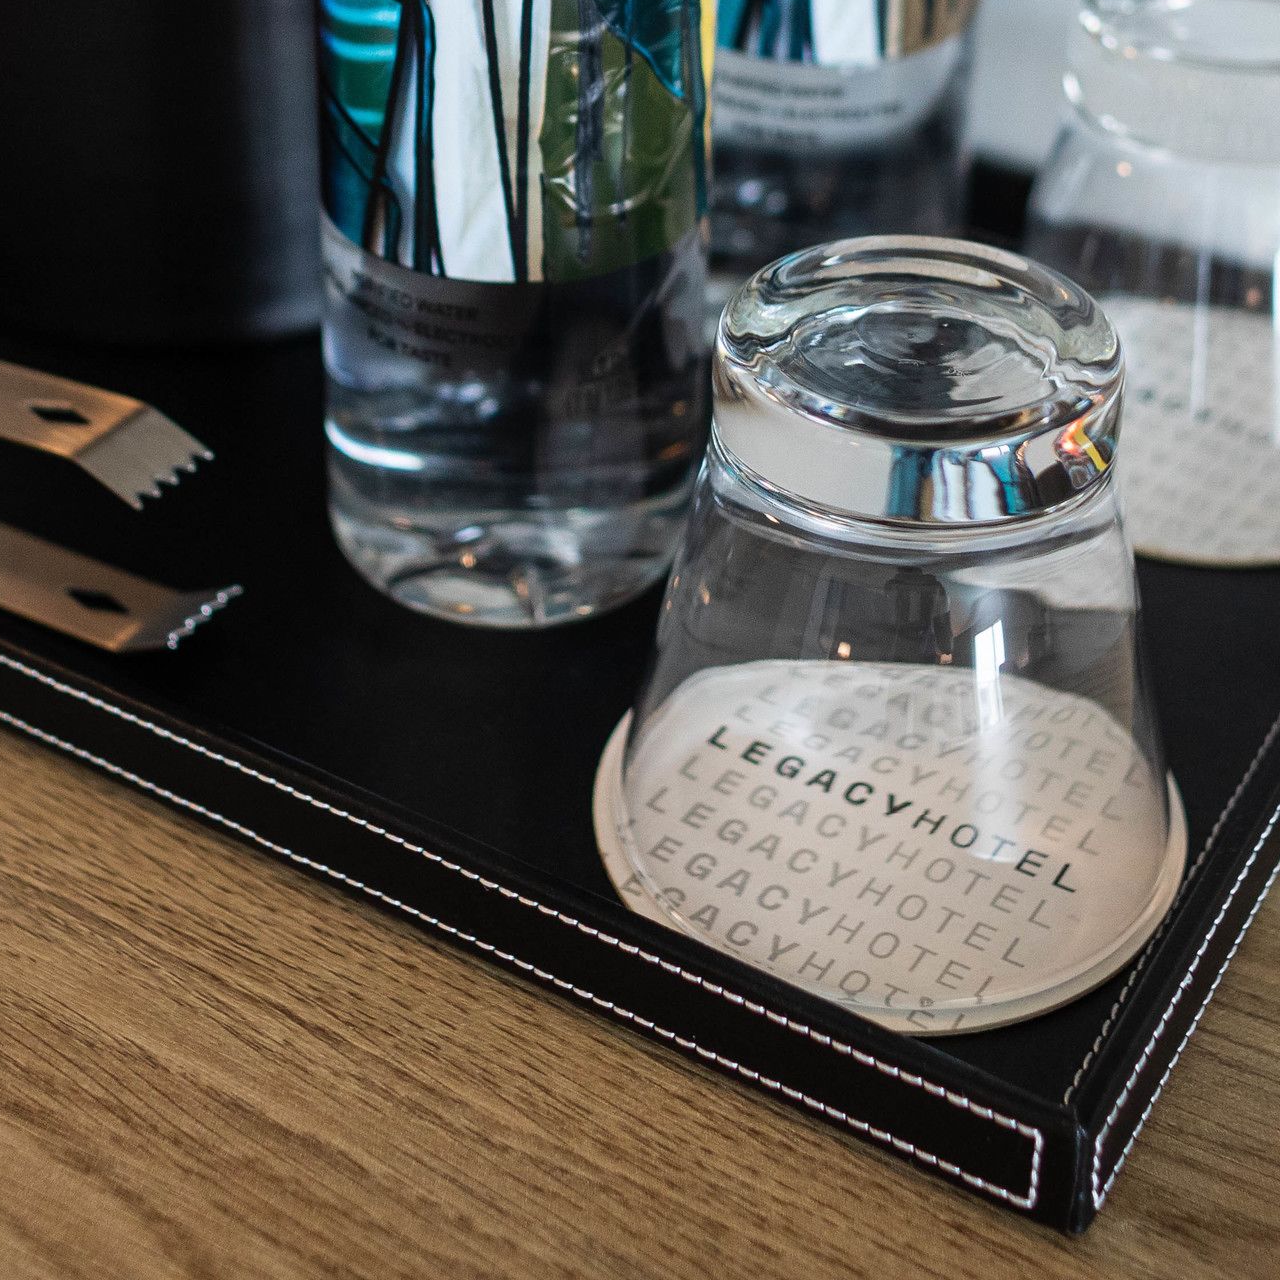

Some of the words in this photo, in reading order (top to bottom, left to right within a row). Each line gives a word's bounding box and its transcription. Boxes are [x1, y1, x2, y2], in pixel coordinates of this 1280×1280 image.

[645, 786, 1025, 968] LEGACYHOTEL
[679, 753, 1051, 930] LEGACYHOTEL
[707, 724, 1077, 893] LEGACYHOTEL
